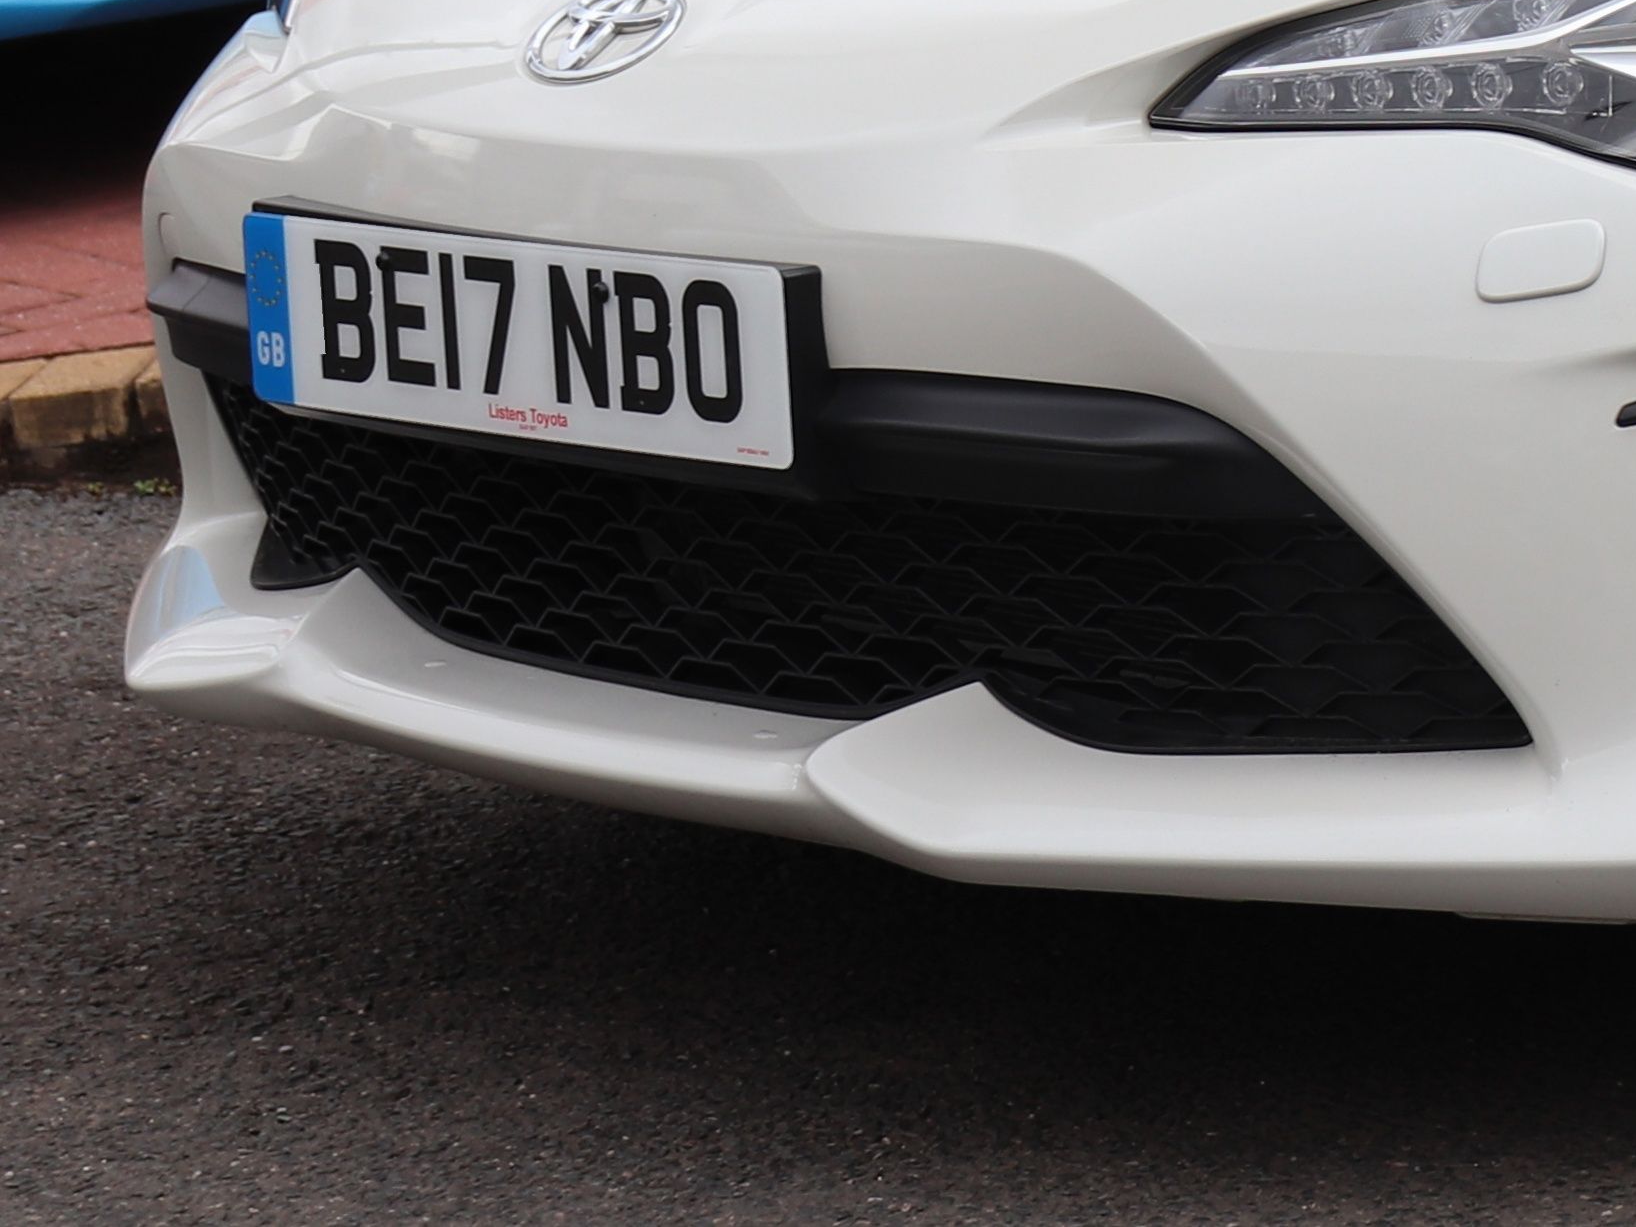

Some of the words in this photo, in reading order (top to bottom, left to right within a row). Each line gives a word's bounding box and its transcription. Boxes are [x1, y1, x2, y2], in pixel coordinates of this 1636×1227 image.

[256, 329, 286, 369] GB
[313, 238, 515, 395] BE17
[547, 263, 743, 423] NBO
[488, 403, 527, 423] Listers
[528, 408, 569, 429] Toyota
